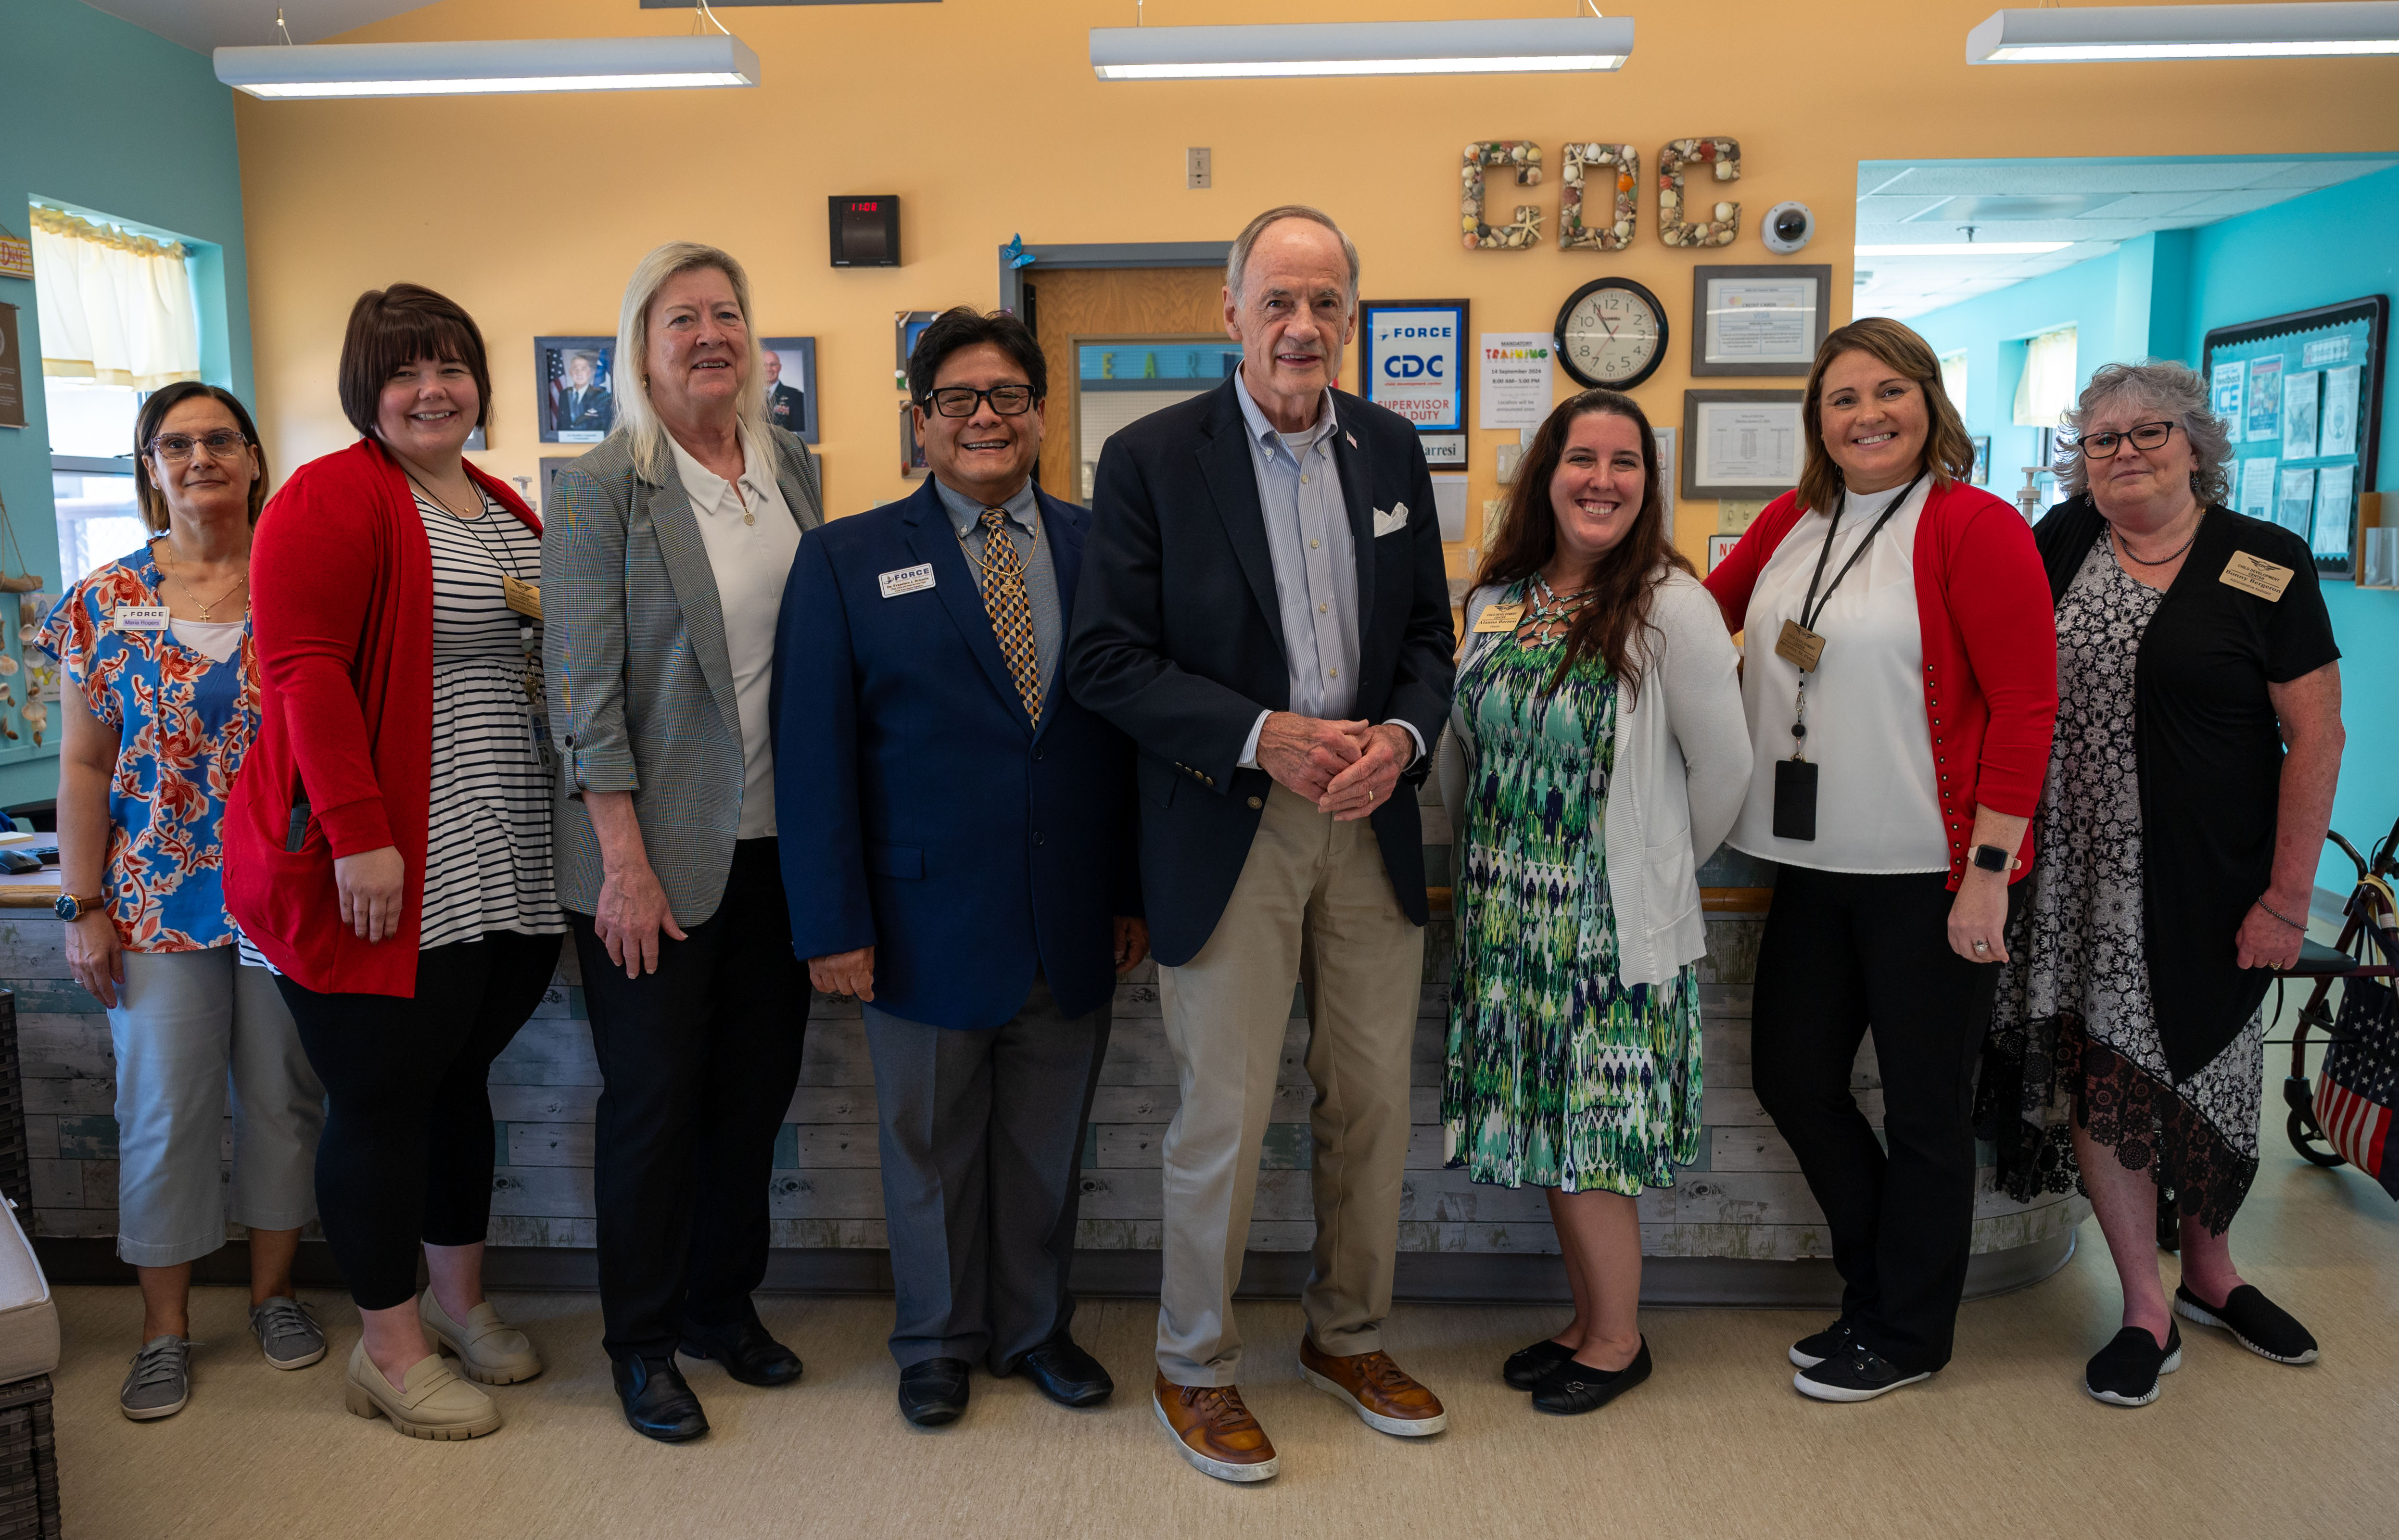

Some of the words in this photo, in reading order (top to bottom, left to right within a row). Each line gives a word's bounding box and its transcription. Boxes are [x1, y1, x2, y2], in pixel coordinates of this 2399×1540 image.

[1461, 137, 1741, 252] CDC
[852, 202, 877, 211] 11:08
[1605, 299, 1618, 310] 12
[1581, 316, 1594, 327] 10
[1634, 315, 1642, 325] 2
[1394, 328, 1451, 338] FORCE
[1576, 330, 1586, 341] 9
[1637, 330, 1645, 341] 3
[1580, 345, 1590, 357] 8
[1633, 346, 1641, 355] 4
[1384, 355, 1443, 378] CDC
[1592, 357, 1599, 367] 7
[1606, 362, 1615, 372] 6
[1621, 356, 1630, 368] 5
[1378, 400, 1449, 410] SUPERVISOR
[1410, 411, 1440, 420] DUTY
[1422, 443, 1456, 456] arresi
[894, 568, 930, 581] FORCE
[2248, 572, 2265, 581] CENTER
[2250, 568, 2280, 582] DEVELOPMENT
[2225, 569, 2248, 581] Bonny
[2249, 579, 2281, 593] Bergeron
[2230, 578, 2255, 589] Administrative
[1804, 654, 1815, 663] Peter
